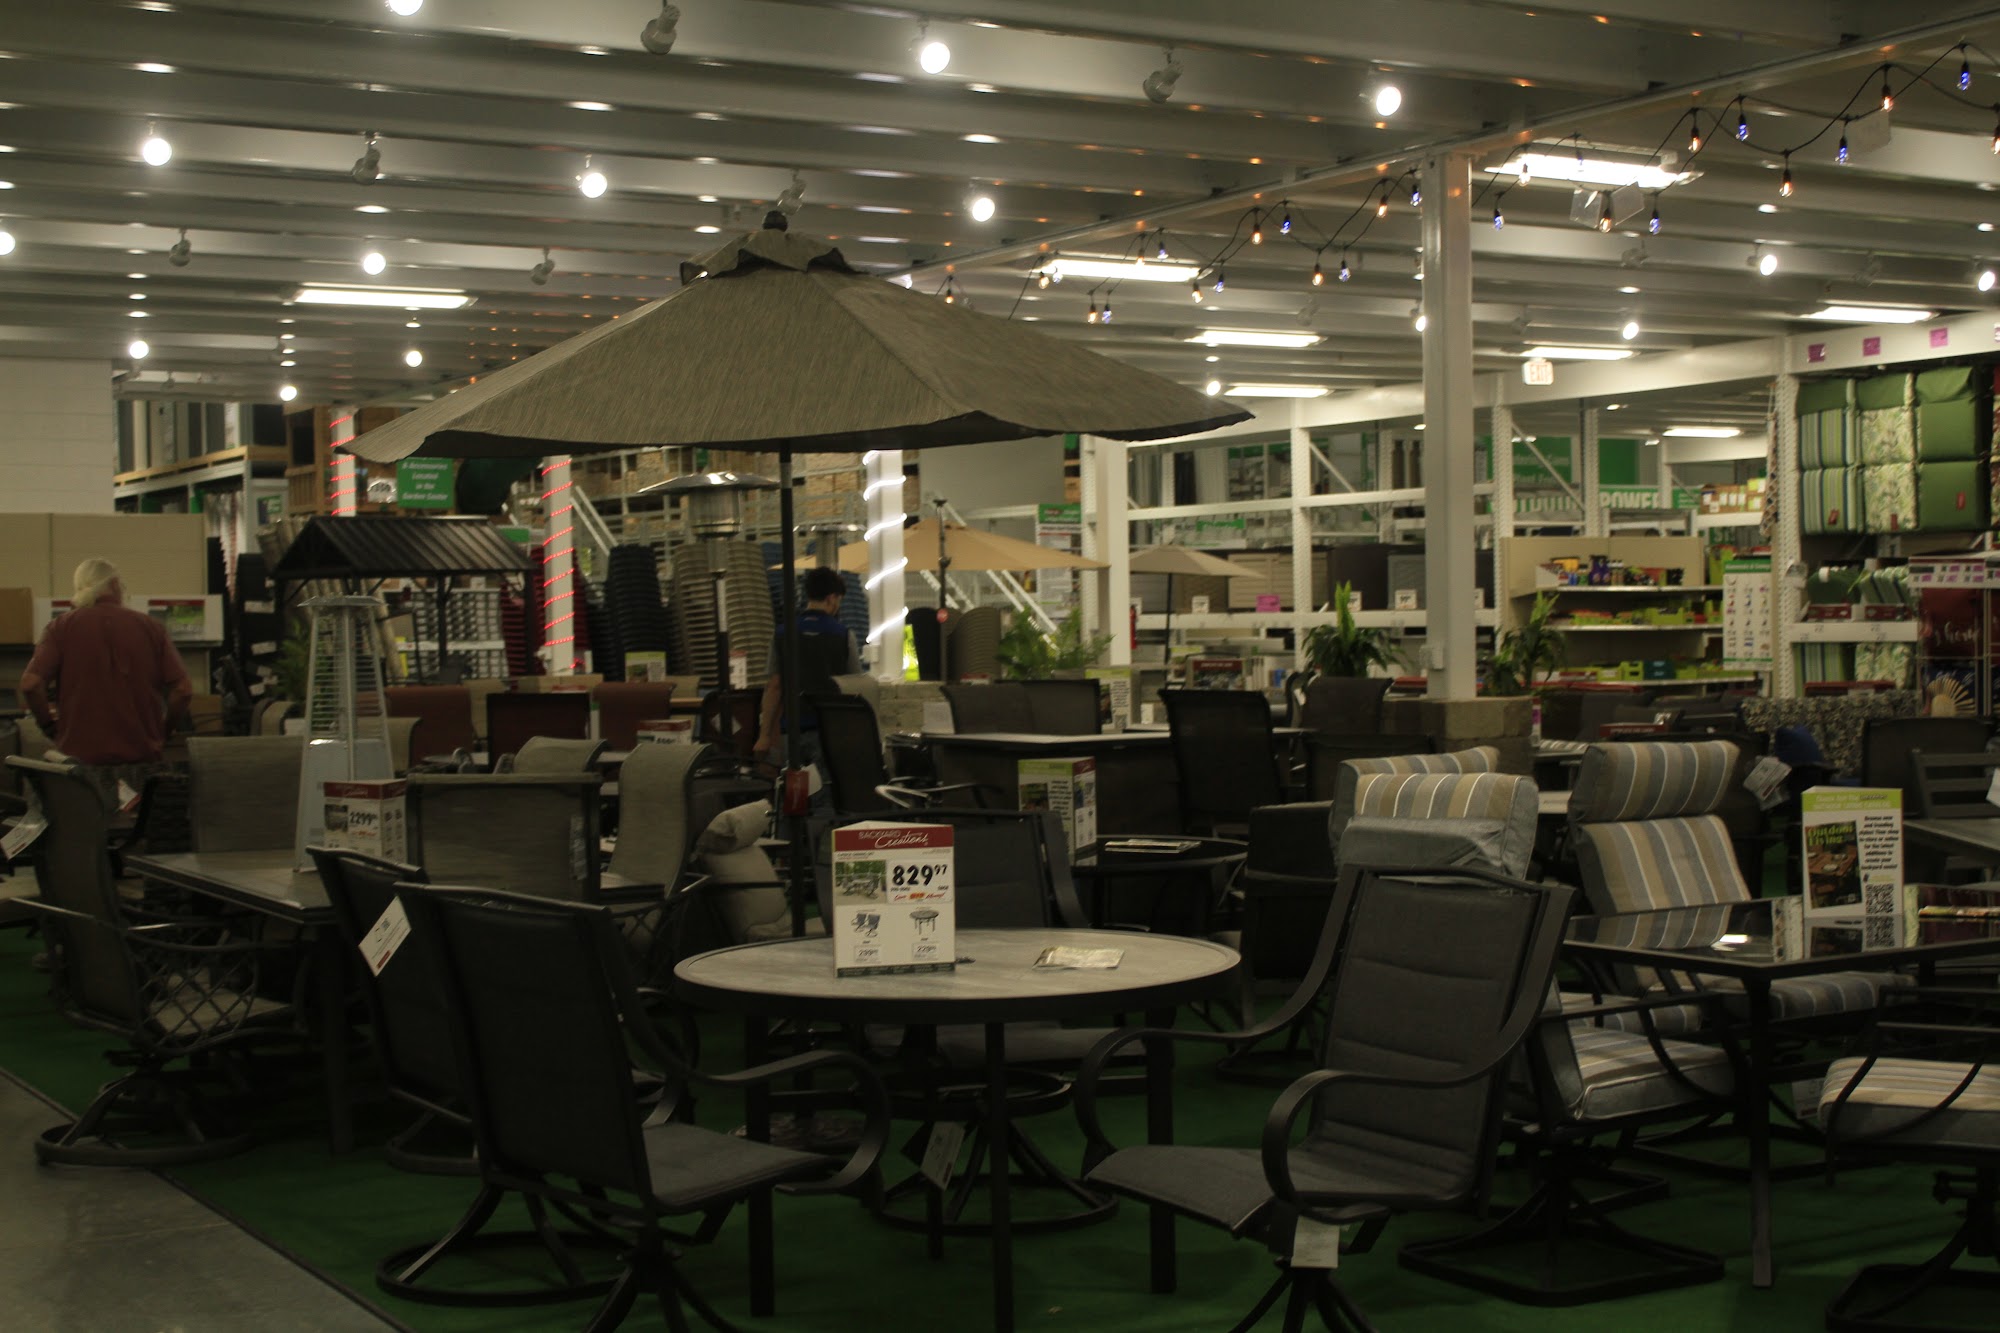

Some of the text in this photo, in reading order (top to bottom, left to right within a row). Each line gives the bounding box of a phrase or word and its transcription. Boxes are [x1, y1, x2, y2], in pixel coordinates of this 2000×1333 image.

[1807, 824, 1855, 837] Outdoor
[874, 830, 929, 849] Creations
[1807, 835, 1845, 847] Living
